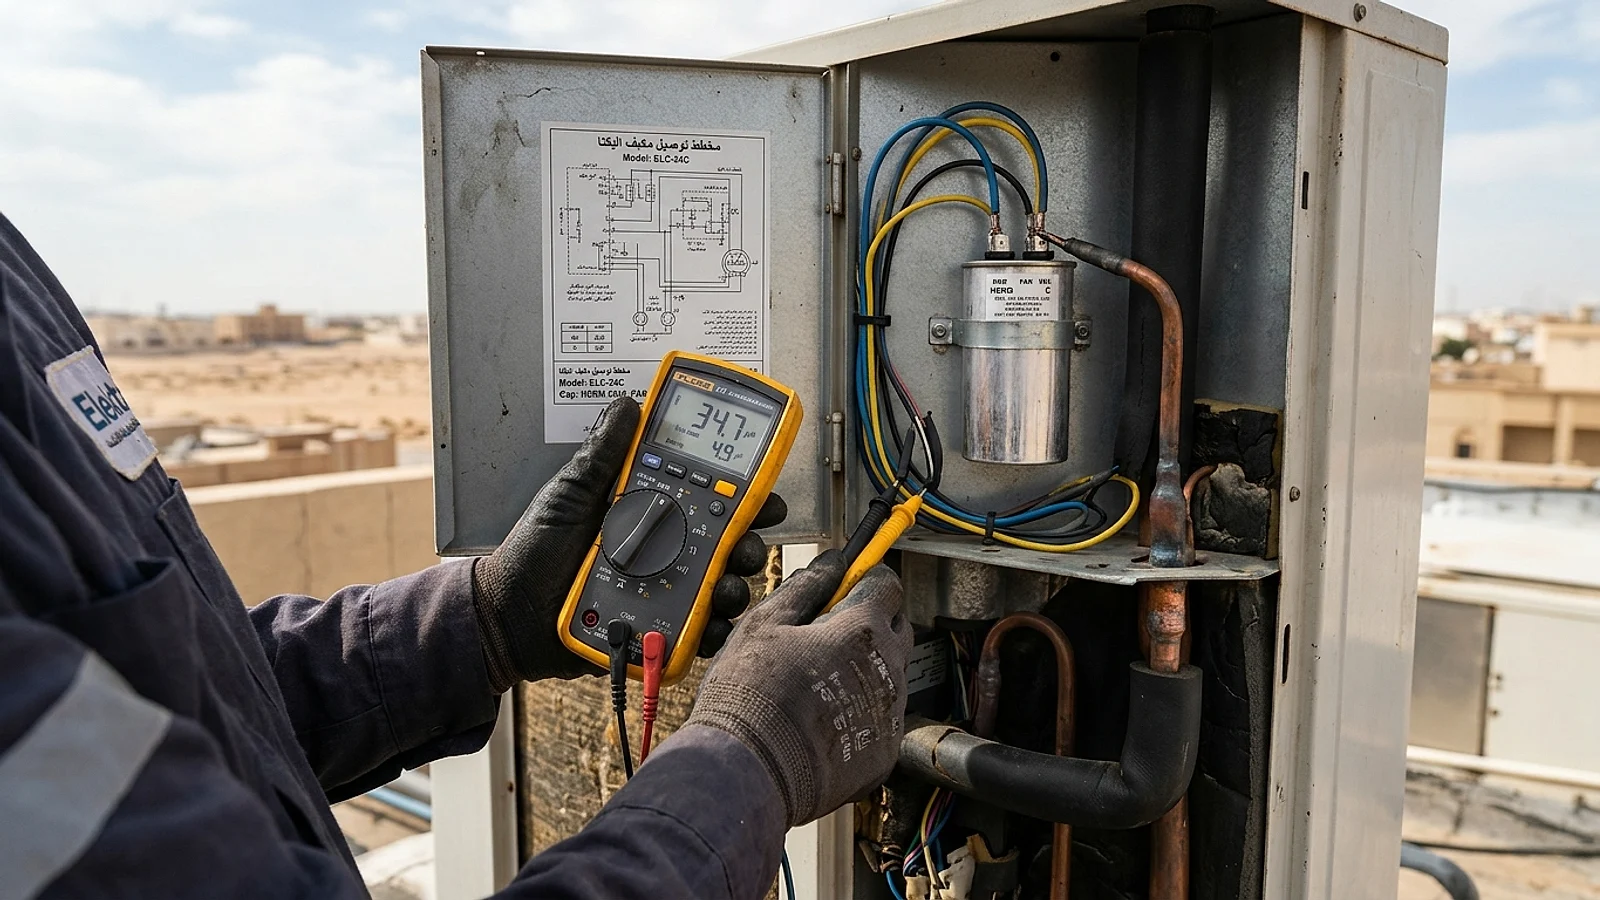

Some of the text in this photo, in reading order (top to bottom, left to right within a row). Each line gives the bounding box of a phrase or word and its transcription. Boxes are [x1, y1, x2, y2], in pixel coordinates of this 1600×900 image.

[622, 153, 652, 162] Model:
[559, 378, 625, 387] Model: ELC-24C
[559, 390, 579, 400] Cap:
[691, 402, 747, 441] 34.7
